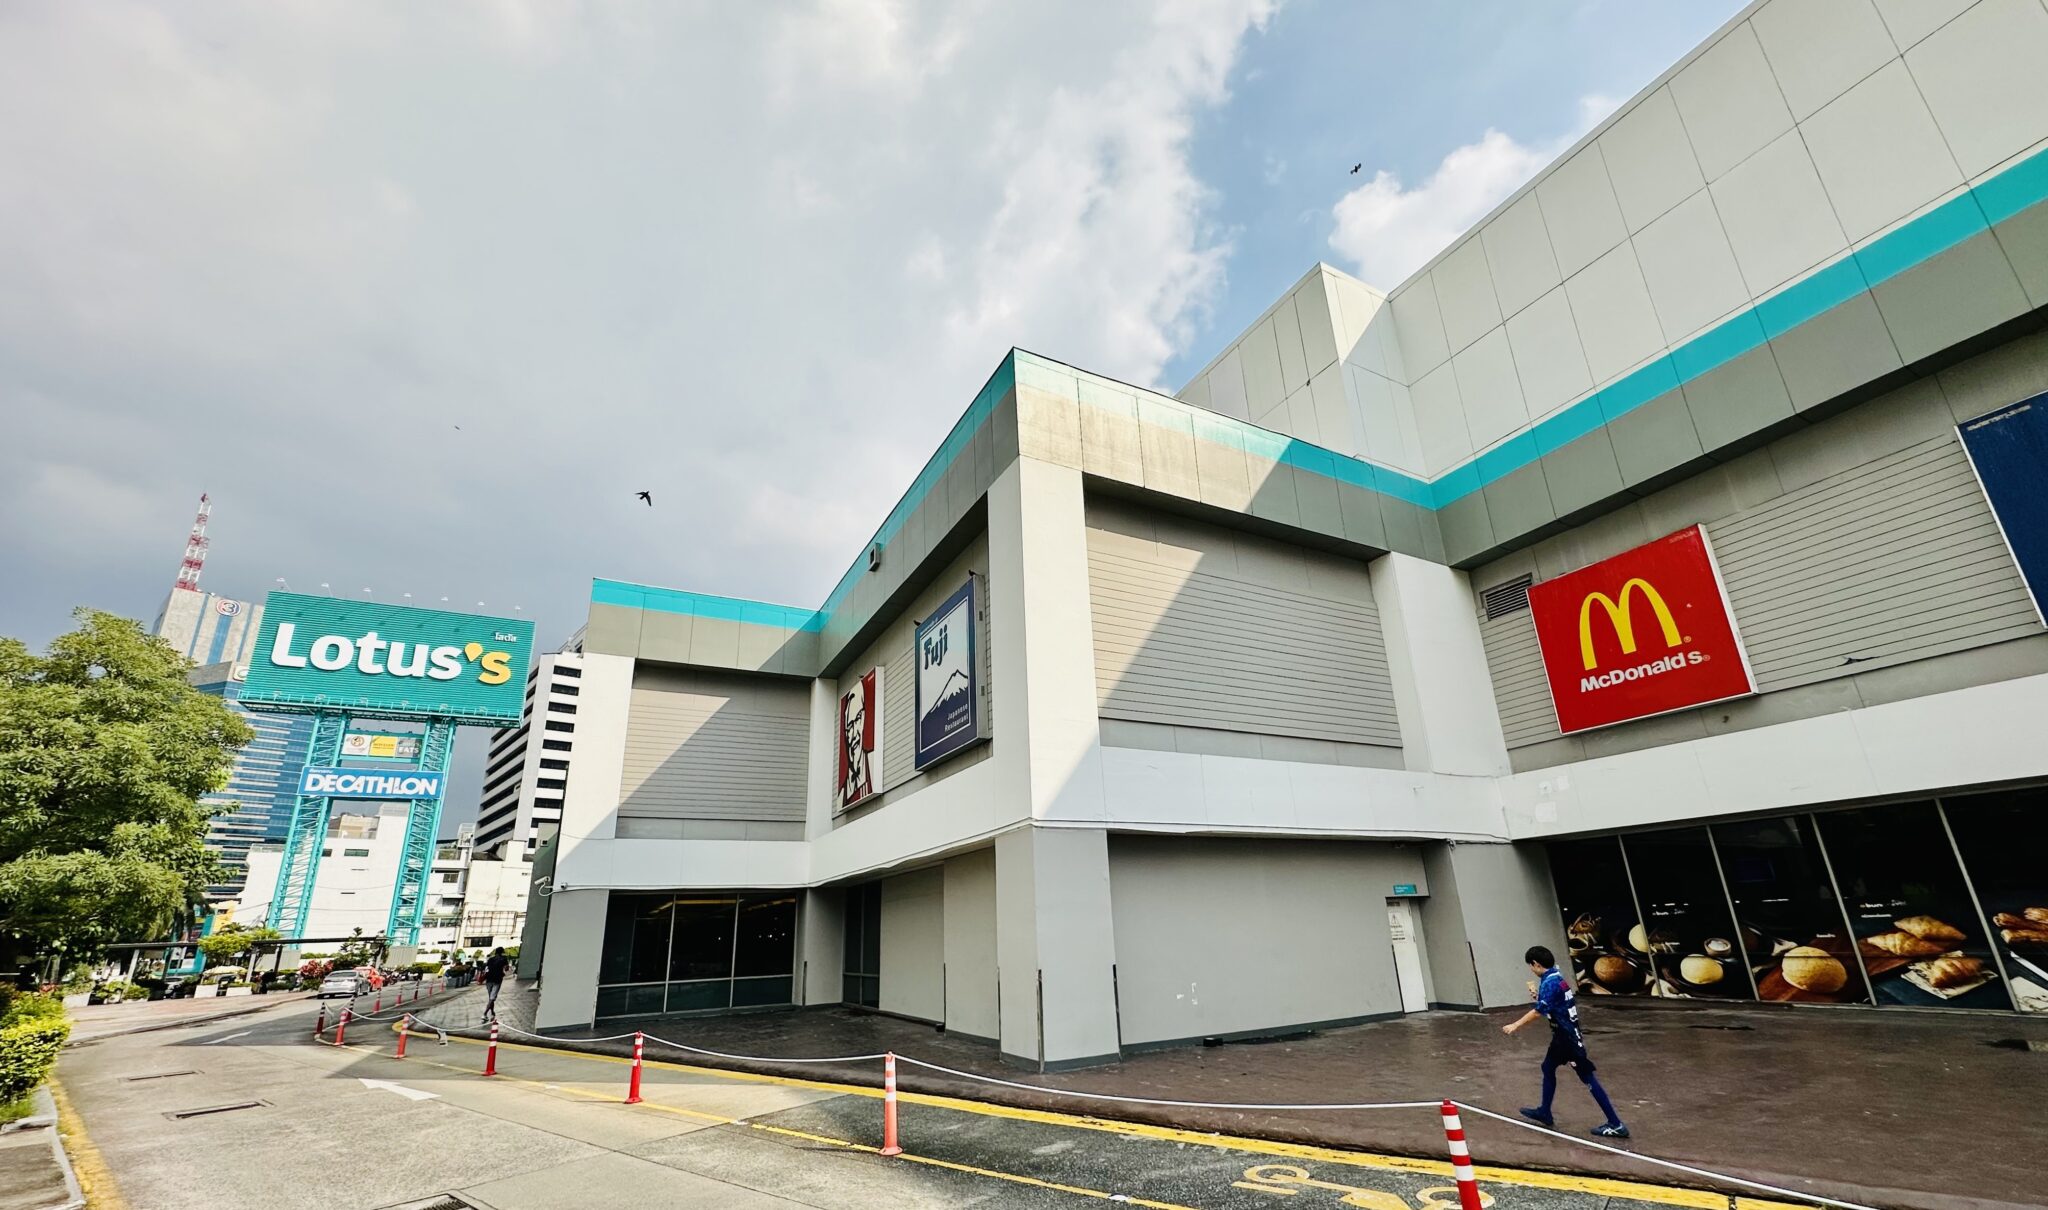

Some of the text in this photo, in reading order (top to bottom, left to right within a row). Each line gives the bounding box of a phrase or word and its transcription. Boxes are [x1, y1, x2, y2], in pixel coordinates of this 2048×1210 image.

[271, 622, 512, 684] Lotus's
[924, 624, 948, 670] Fuji
[1580, 650, 1704, 693] McDonalds
[945, 713, 968, 732] Restaurant
[947, 703, 968, 721] Japanese
[304, 774, 439, 796] DECATHLON
